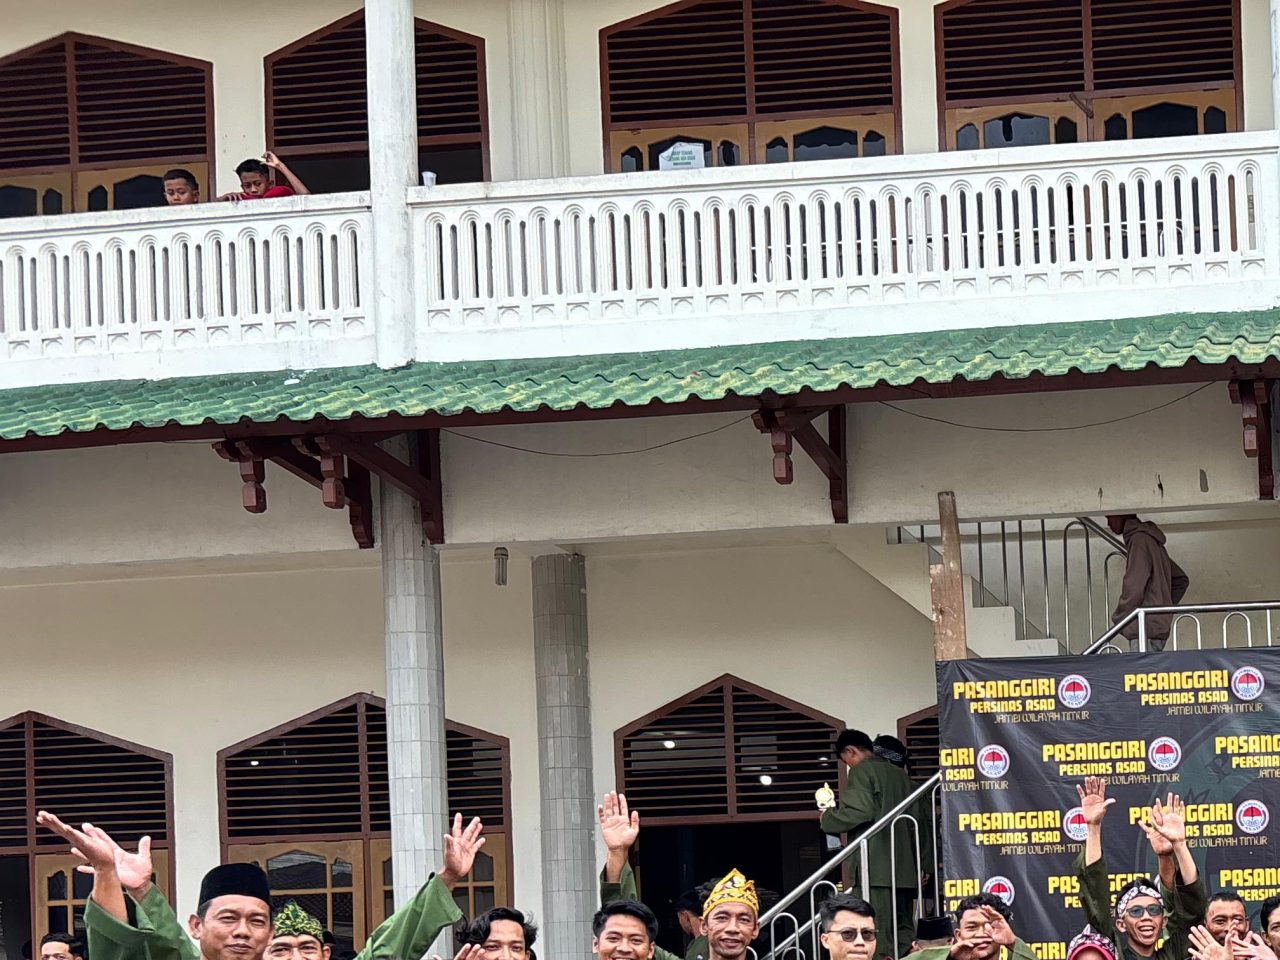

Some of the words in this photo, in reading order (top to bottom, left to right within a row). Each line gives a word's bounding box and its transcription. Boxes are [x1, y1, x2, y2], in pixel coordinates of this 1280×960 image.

[1124, 670, 1228, 692] PASANGGIRI
[953, 678, 1055, 699] PASANGGIRI
[1141, 692, 1195, 706] PERSINAS
[1199, 691, 1228, 703] ASAD
[970, 700, 1022, 713] PERSINAS
[1026, 699, 1055, 711] ASAD
[1195, 704, 1233, 714] WILAYAH
[1234, 703, 1263, 712] TIMUR
[1022, 712, 1060, 722] WILAYAH
[1061, 711, 1089, 721] TIMUR
[941, 748, 974, 766] GIRI
[1042, 740, 1145, 762] PASANGGIRI
[946, 769, 974, 780] ASAD
[1059, 762, 1112, 776] PERSINAS
[1116, 761, 1145, 773] ASAD
[981, 781, 1008, 790] TIMUR
[1112, 775, 1150, 785] WILAYAH
[1152, 773, 1180, 783] TIMUR
[959, 810, 1060, 831] PASANGGIRI
[1203, 824, 1232, 836] ASAD
[976, 832, 1028, 845] PERSINAS
[1032, 831, 1060, 843] ASAD
[1199, 837, 1237, 847] WILAYAH
[1239, 836, 1268, 845] TIMUR
[1000, 846, 1026, 856] JAMBI
[1028, 845, 1065, 854] WILAYAH
[1067, 844, 1086, 853] TIM
[944, 879, 980, 897] GIRI
